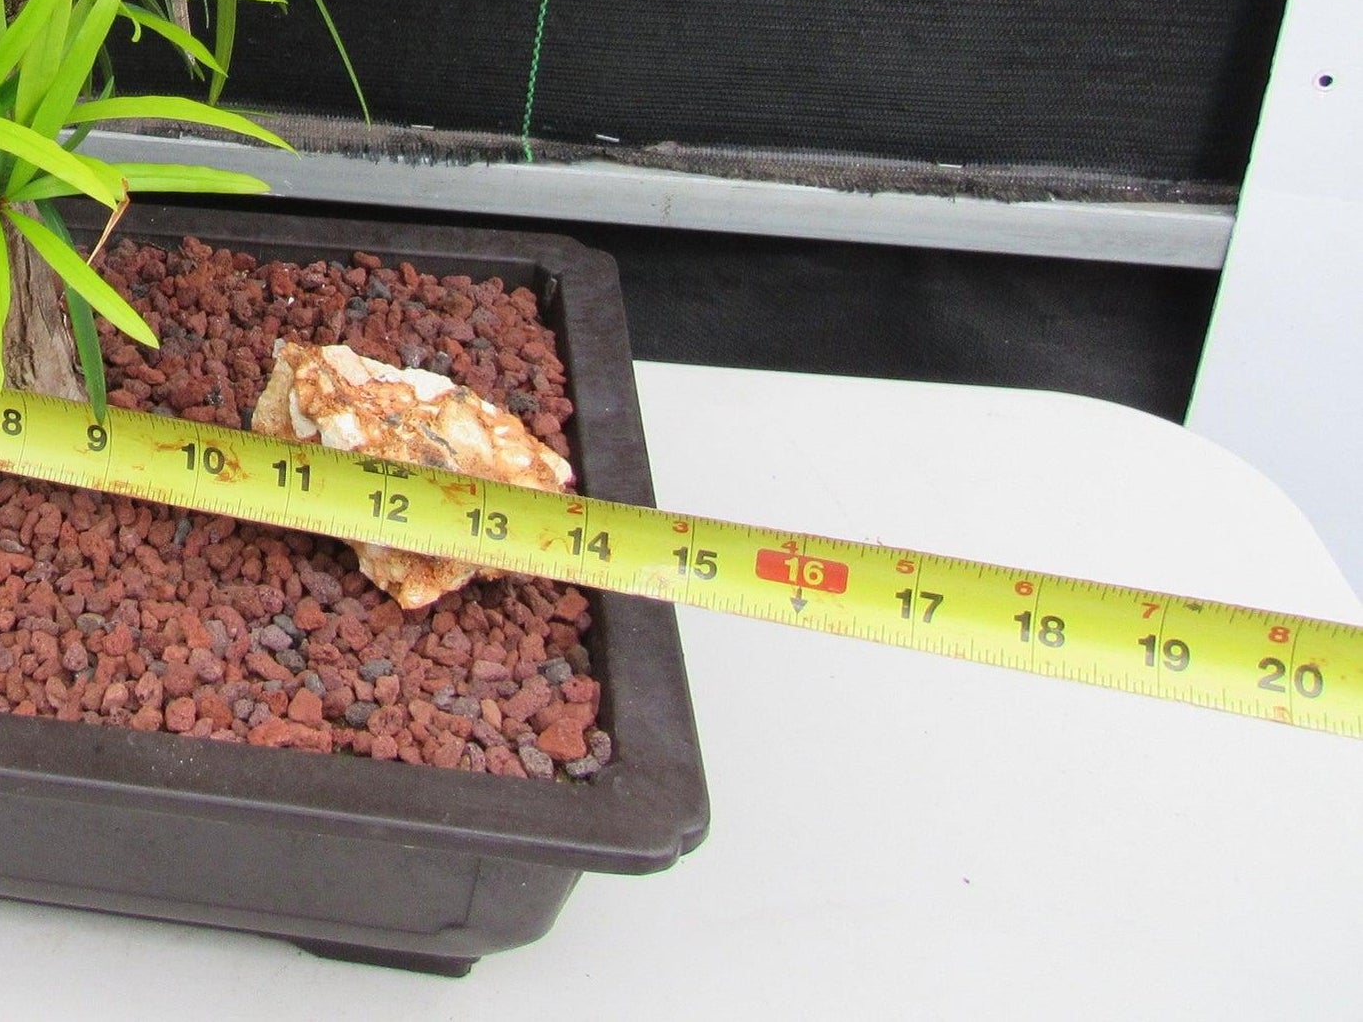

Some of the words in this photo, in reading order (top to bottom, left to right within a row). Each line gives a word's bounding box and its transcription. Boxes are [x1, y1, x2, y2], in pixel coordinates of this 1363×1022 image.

[1, 408, 23, 436] 8
[86, 424, 108, 452] 9
[181, 443, 225, 475] 10
[272, 460, 311, 491] 11
[368, 490, 410, 523] 12
[466, 508, 508, 540] 13
[567, 526, 611, 561] 14
[672, 546, 718, 580] 15
[784, 555, 825, 586] 16
[895, 588, 944, 623] 17
[1014, 610, 1066, 648] 18
[1138, 634, 1190, 672] 19
[1257, 657, 1324, 699] 20
[567, 502, 583, 515] 2
[672, 520, 689, 534] 3
[781, 540, 799, 554] 4
[896, 559, 915, 574] 5
[1013, 580, 1034, 597] 6
[1140, 603, 1160, 619] 7
[1267, 626, 1291, 644] 8
